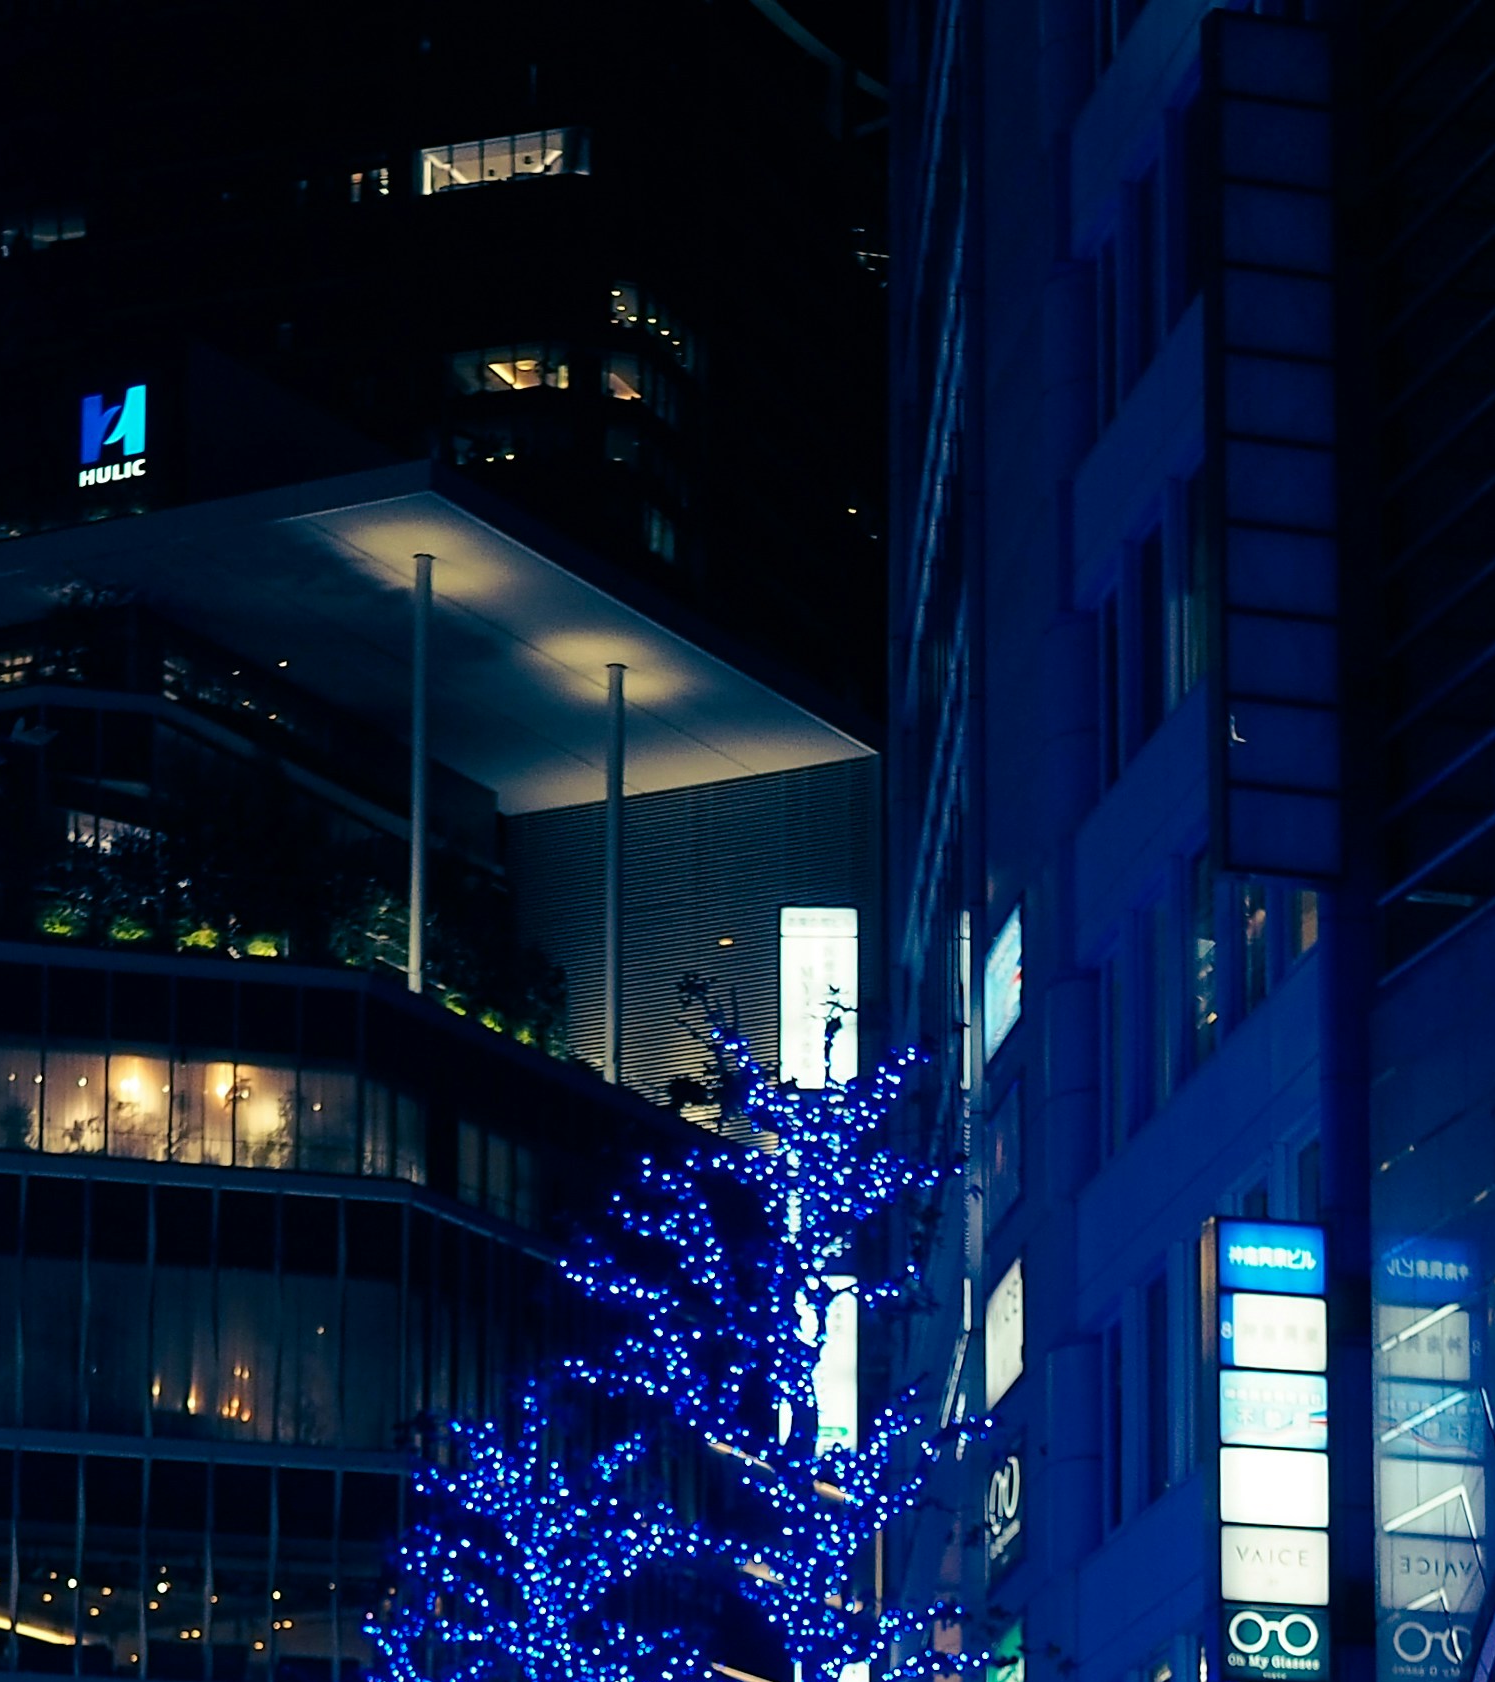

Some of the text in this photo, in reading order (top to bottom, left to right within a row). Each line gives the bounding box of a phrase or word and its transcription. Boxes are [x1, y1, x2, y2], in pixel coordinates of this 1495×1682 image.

[78, 457, 147, 487] HULIC
[1235, 1544, 1311, 1567] VAICE
[1248, 1654, 1269, 1670] My
